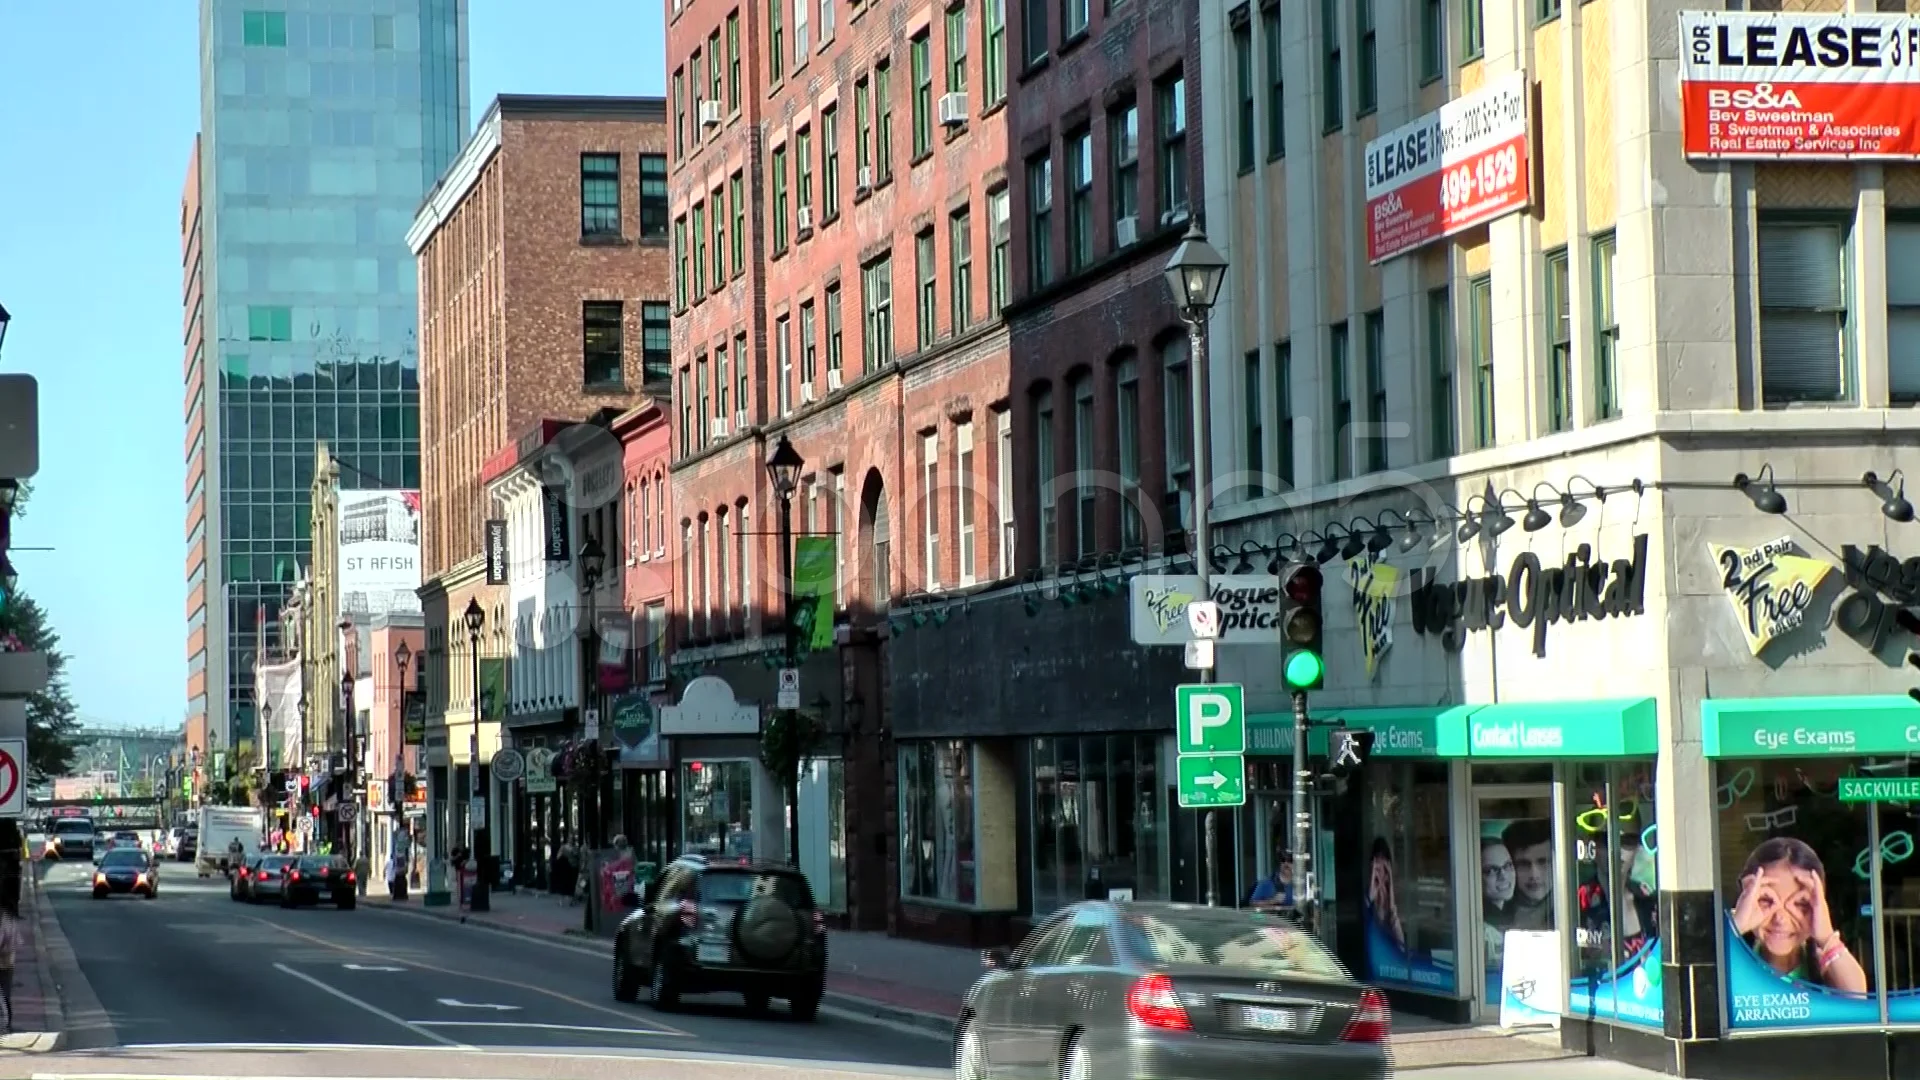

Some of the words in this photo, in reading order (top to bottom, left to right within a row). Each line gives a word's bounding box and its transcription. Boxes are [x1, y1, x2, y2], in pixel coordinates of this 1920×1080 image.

[1693, 26, 1711, 64] FOR
[1717, 26, 1882, 67] LEASE
[1891, 29, 1901, 67] 3
[1708, 82, 1802, 108] BS&A
[1709, 110, 1740, 122] Bev
[1745, 109, 1834, 122] Sweetman
[1709, 124, 1724, 136] B.
[1728, 124, 1803, 136] Sweetman
[1808, 124, 1819, 136] &
[1823, 124, 1900, 136] Associates
[1709, 137, 1741, 149] Real
[1746, 137, 1790, 149] Estate
[1794, 137, 1855, 149] Services
[1859, 138, 1881, 149] Inc
[1375, 127, 1428, 185] LEASE
[1440, 144, 1517, 211] 499-1529
[1764, 540, 1791, 557] Pair
[1507, 533, 1649, 658] Optical
[1736, 563, 1812, 635] Free
[1153, 594, 1184, 627] Free
[1189, 693, 1232, 745] P
[1389, 726, 1423, 748] Exams
[1473, 720, 1518, 748] Contact
[1520, 720, 1563, 748] Lenses
[1754, 729, 1789, 749] Eye
[1794, 728, 1856, 745] Exams
[1845, 782, 1919, 797] SACKVILLE
[1734, 995, 1760, 1008] EYE
[1762, 992, 1810, 1007] EXAMS
[1735, 1006, 1811, 1022] ARRANGED
